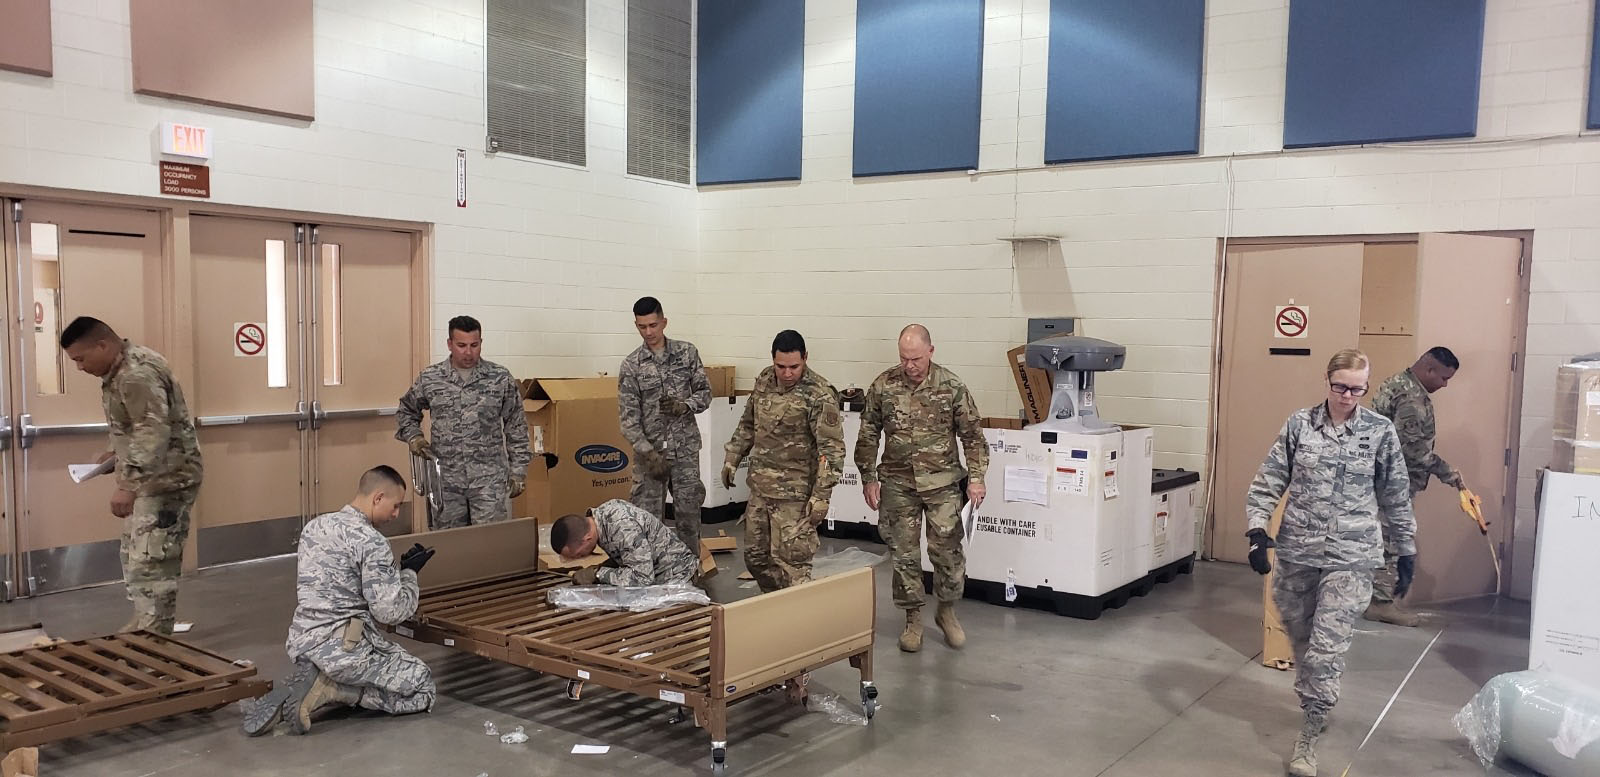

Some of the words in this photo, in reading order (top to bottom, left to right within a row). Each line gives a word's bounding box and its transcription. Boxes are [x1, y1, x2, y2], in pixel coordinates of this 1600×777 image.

[174, 125, 205, 152] EXIT
[164, 164, 189, 172] MAXIMUM
[164, 172, 197, 180] OCCUPANCY
[181, 187, 206, 195] PERSONS
[581, 451, 621, 465] INVACARE
[592, 479, 604, 487] Yes,
[605, 478, 617, 487] you
[977, 515, 998, 525] ANDLE
[1000, 518, 1017, 527] WITH
[1018, 520, 1036, 529] CARE
[976, 523, 1001, 534] EUSABLE
[1003, 526, 1036, 538] CONTAINER
